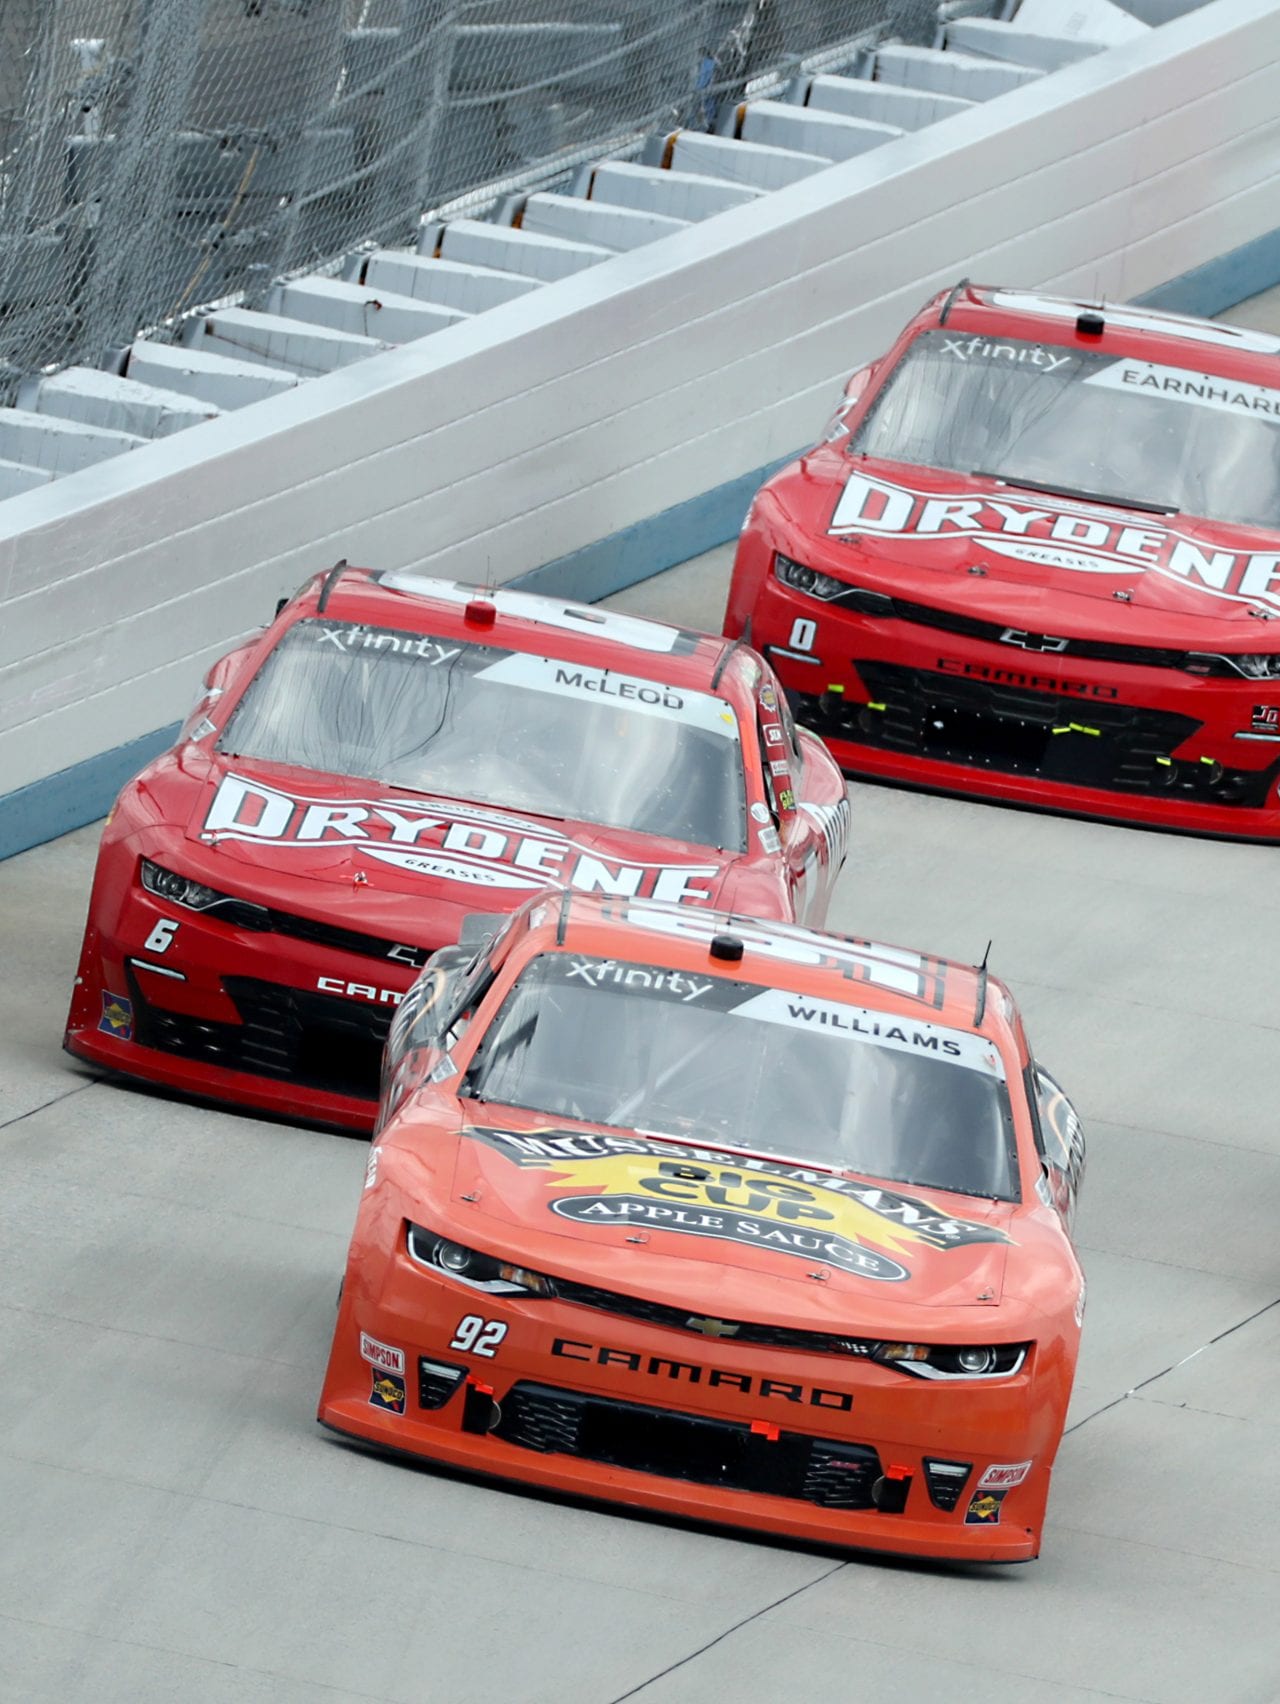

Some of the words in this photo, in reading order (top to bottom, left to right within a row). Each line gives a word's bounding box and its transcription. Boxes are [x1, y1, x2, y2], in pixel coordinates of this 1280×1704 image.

[939, 337, 1071, 372] xfinity
[1015, 547, 1099, 568] GREASES
[317, 625, 462, 664] xfinity
[788, 617, 817, 651] 0
[555, 669, 684, 710] McLEOD
[937, 658, 1118, 699] CAMARO
[205, 777, 719, 903] DRYDENE
[405, 859, 496, 882] GREASES
[144, 918, 180, 953] 6
[317, 976, 404, 1004] CAM
[566, 960, 713, 1000] xfinity
[787, 1003, 961, 1056] WILLIAMS
[638, 1177, 835, 1221] CUP
[658, 1161, 816, 1201] BIG
[579, 1199, 724, 1231] APPLE
[735, 1221, 881, 1271] SAUCE
[362, 1338, 400, 1369] SIMPSON
[450, 1314, 508, 1358] 92
[374, 1381, 405, 1399] SUNOCO
[551, 1337, 854, 1412] CAMARO
[984, 1465, 1026, 1484] SIMPSON
[969, 1500, 1000, 1512] SUNOCO
